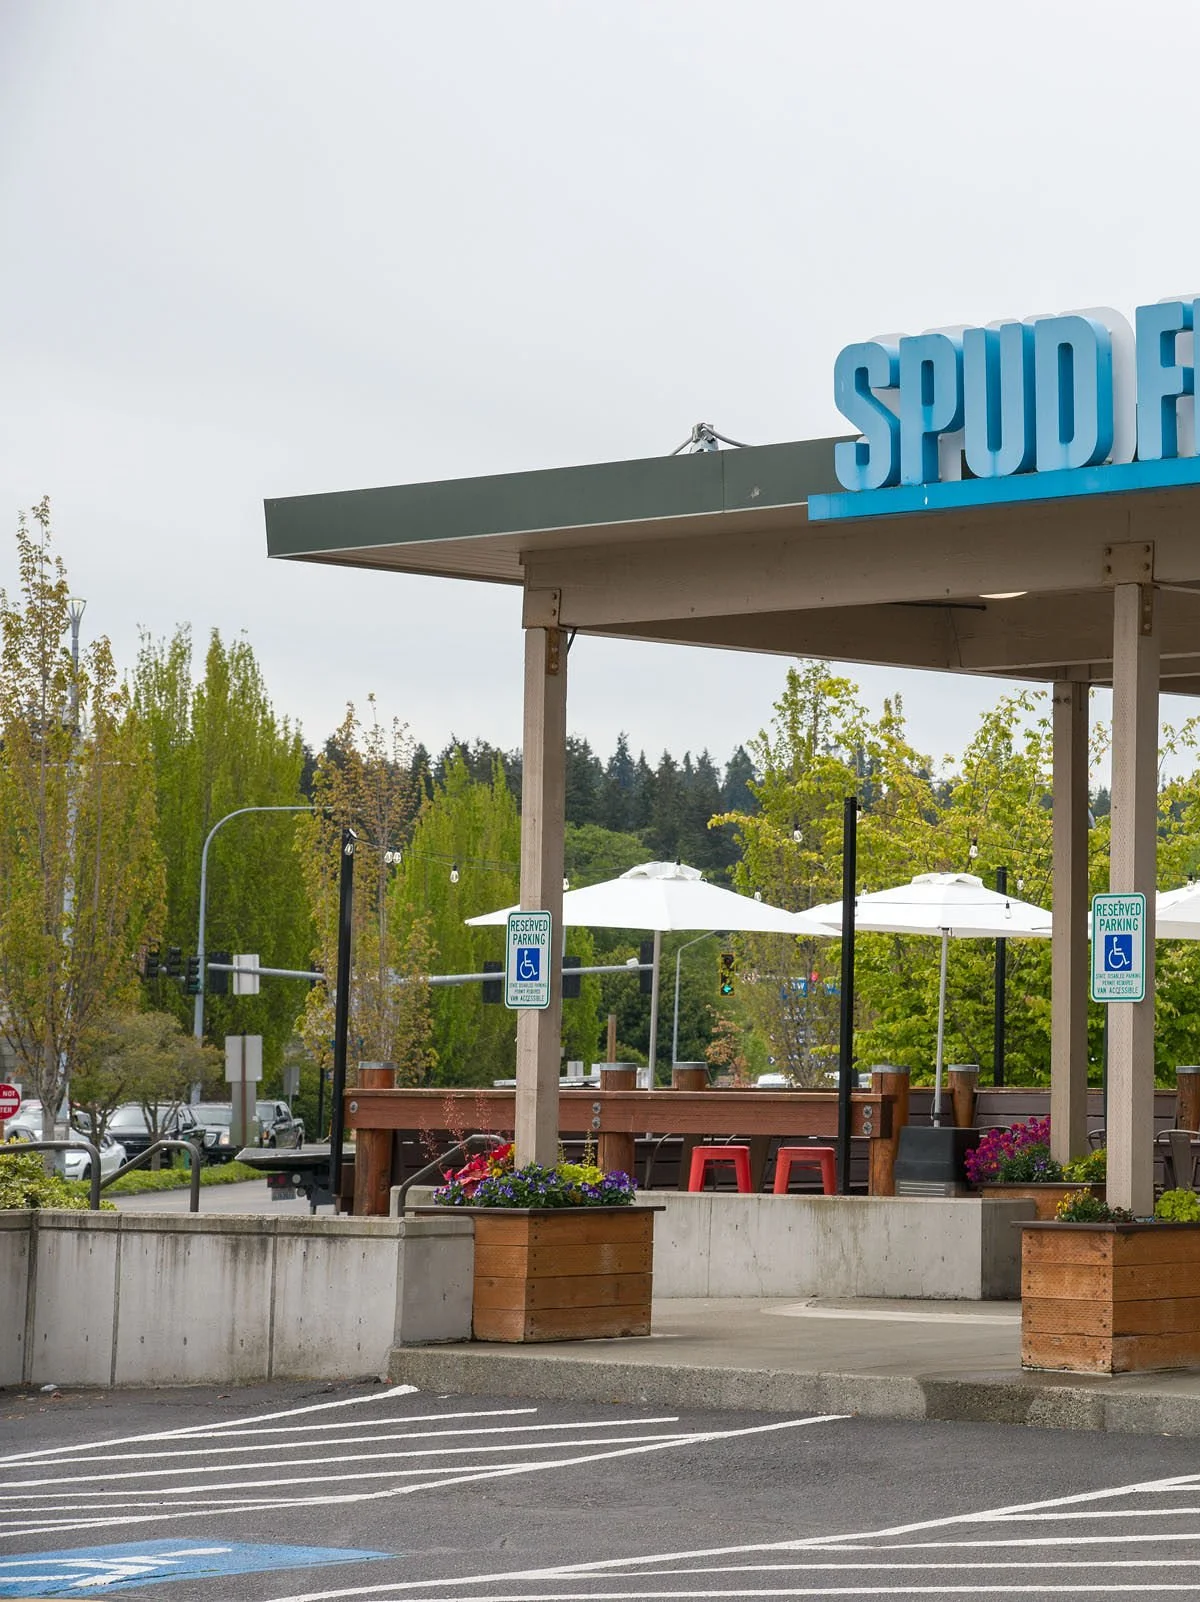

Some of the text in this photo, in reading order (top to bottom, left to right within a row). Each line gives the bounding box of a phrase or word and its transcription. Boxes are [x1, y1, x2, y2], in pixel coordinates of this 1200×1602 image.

[834, 315, 1113, 491] SPUD
[1096, 902, 1141, 917] RESERVED
[510, 919, 548, 932] RESERVED
[1099, 918, 1139, 931] PARKING
[512, 933, 546, 945] PARKING
[1097, 986, 1138, 994] VAN ACCESSIBLE
